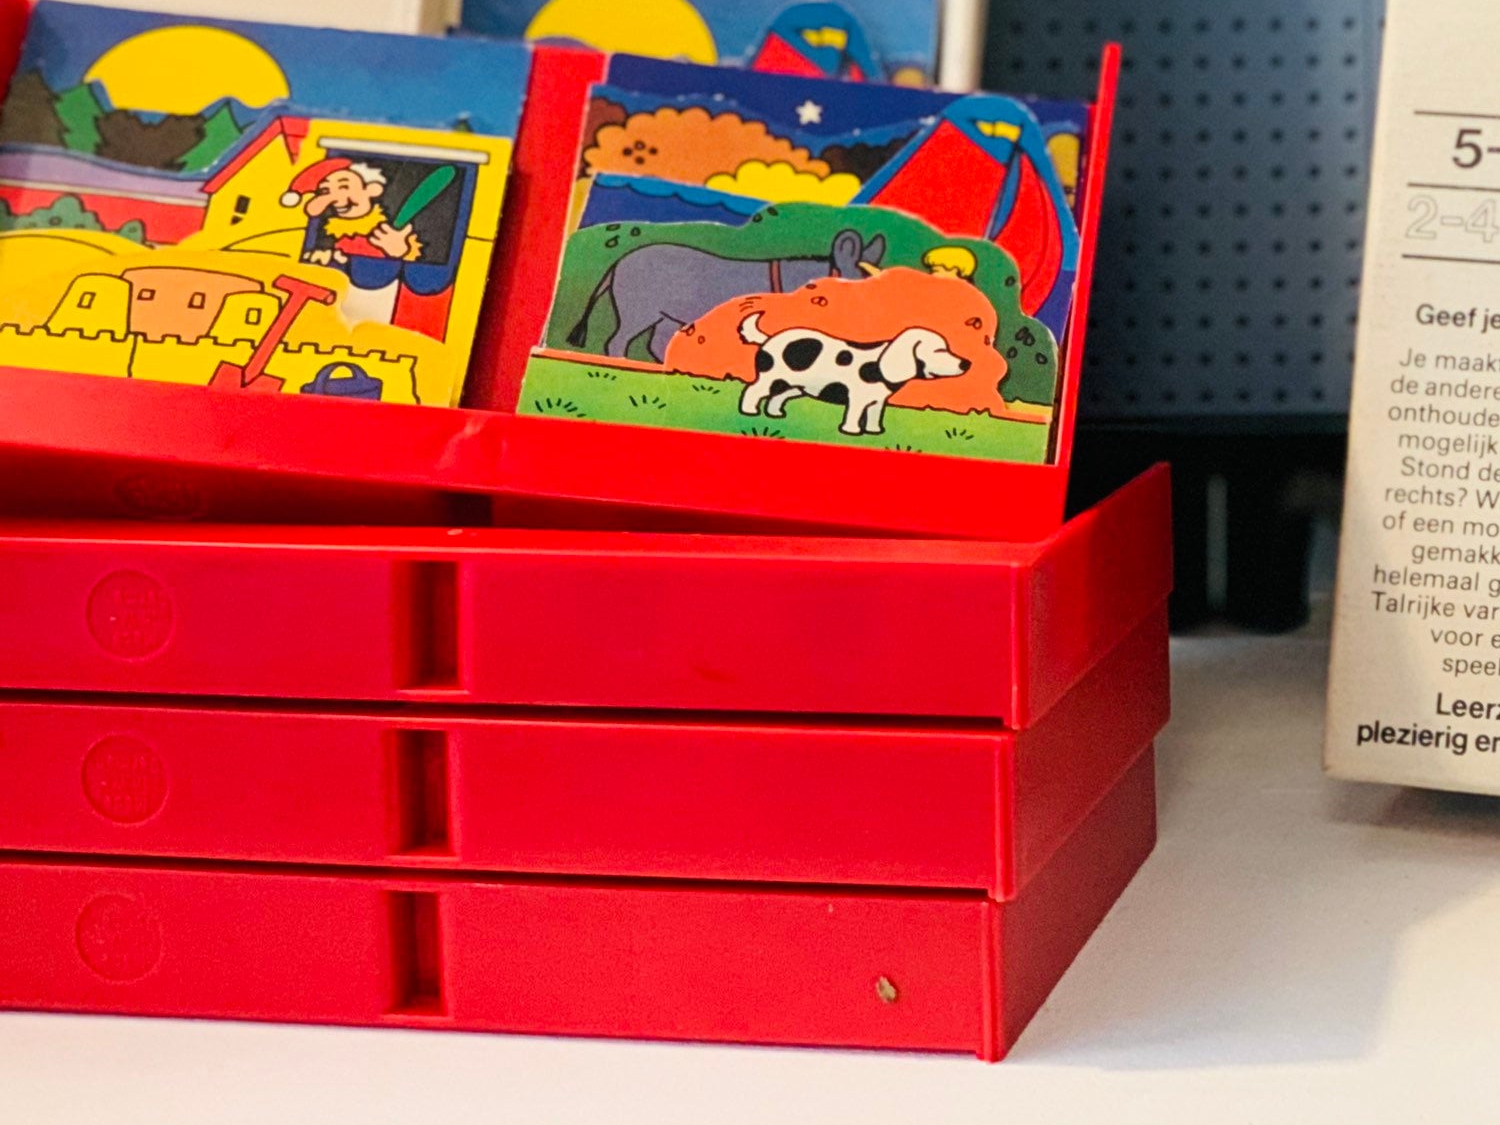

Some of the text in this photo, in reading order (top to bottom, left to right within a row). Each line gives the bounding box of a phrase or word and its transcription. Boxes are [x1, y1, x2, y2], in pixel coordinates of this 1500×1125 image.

[1404, 194, 1500, 244] 2-4
[1416, 303, 1477, 328] Geef
[1399, 348, 1426, 368] Je
[1391, 375, 1418, 395] de
[1398, 434, 1498, 459] mogelijk
[1401, 456, 1470, 480] Stond
[1385, 485, 1468, 507] rechts?
[1383, 510, 1406, 530] of
[1413, 517, 1454, 533] een
[1374, 564, 1479, 591] helemaal
[1371, 591, 1455, 619] Talrijke
[1431, 629, 1484, 646] voor
[1356, 720, 1468, 756] plezierig
